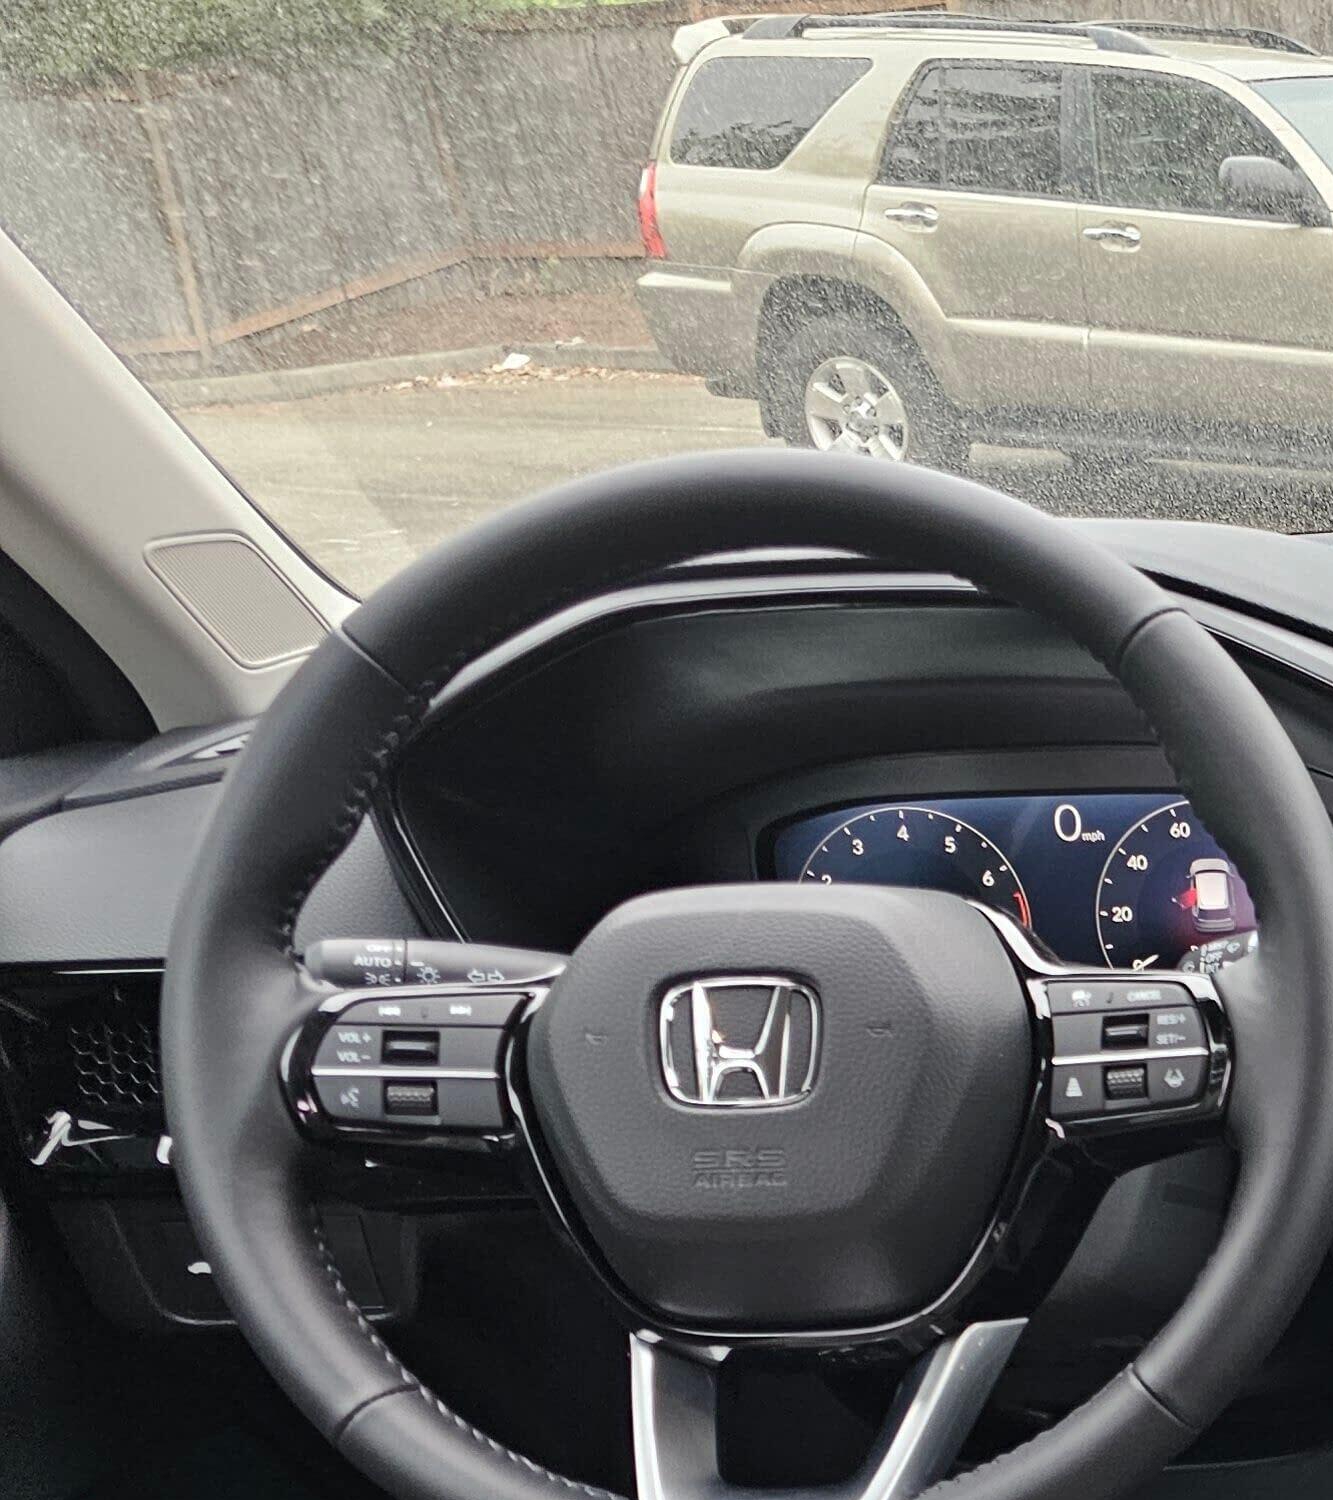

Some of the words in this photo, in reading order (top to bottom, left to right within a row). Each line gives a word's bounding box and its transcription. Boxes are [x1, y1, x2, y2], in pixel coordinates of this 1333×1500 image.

[1054, 804, 1082, 842] 0
[1081, 829, 1106, 843] mph
[1169, 822, 1191, 839] 60
[897, 825, 910, 842] 4
[852, 839, 865, 855] 3
[944, 836, 957, 854] 5
[1126, 854, 1148, 871] 40
[982, 870, 995, 887] 6
[1111, 906, 1133, 923] 20
[353, 956, 392, 968] AUTO
